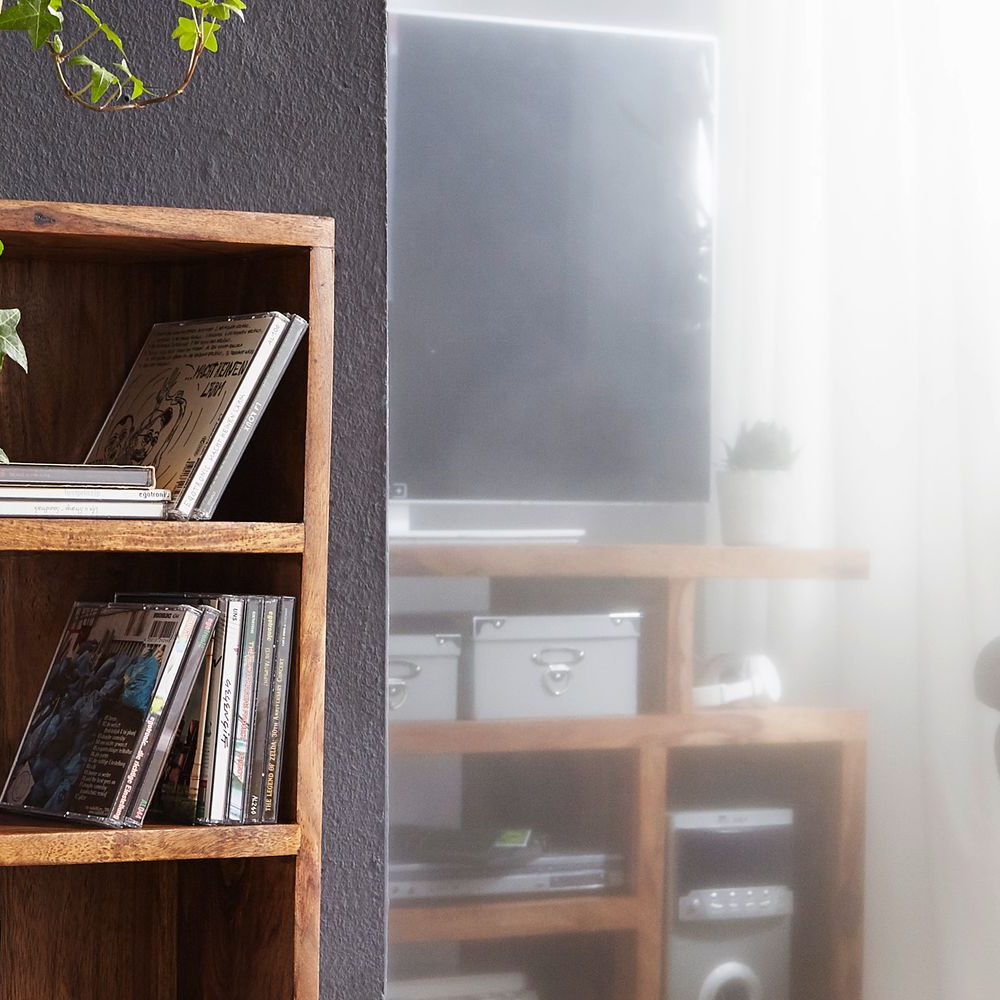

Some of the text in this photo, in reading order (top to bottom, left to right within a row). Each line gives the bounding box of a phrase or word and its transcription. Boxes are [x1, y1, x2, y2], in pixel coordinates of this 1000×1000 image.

[244, 411, 257, 433] ROUX
[268, 763, 275, 772] OF
[266, 772, 275, 798] LEGEND
